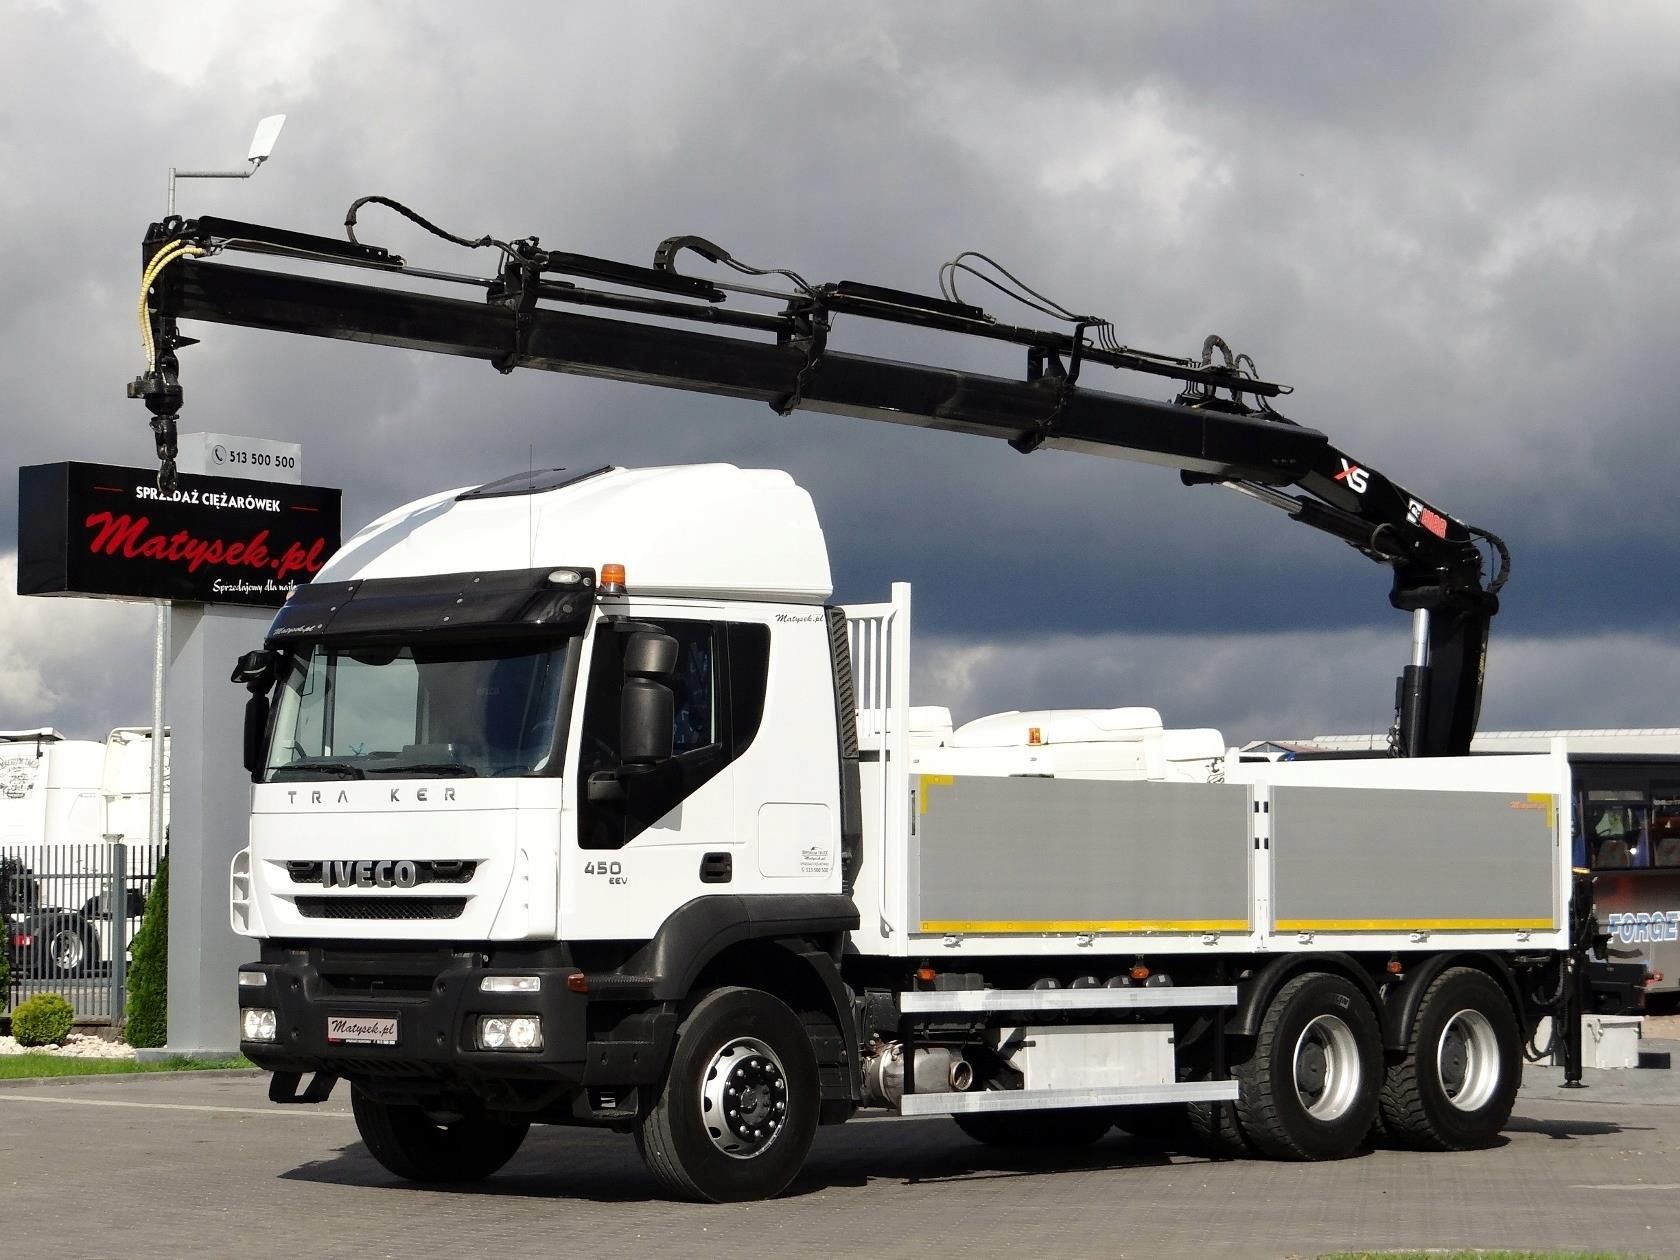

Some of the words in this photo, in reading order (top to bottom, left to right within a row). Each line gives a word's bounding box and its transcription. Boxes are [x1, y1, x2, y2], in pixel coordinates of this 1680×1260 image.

[229, 450, 248, 464] 513
[251, 453, 271, 466] 500
[274, 455, 295, 469] 500
[201, 491, 281, 513] CIĘŻARÓWEK
[86, 511, 326, 579] Matysek.pl
[264, 578, 277, 592] dla
[321, 860, 416, 889] IVECO
[584, 861, 622, 875] 450
[608, 877, 628, 885] EEV
[331, 1020, 395, 1037] Matysek.pl
